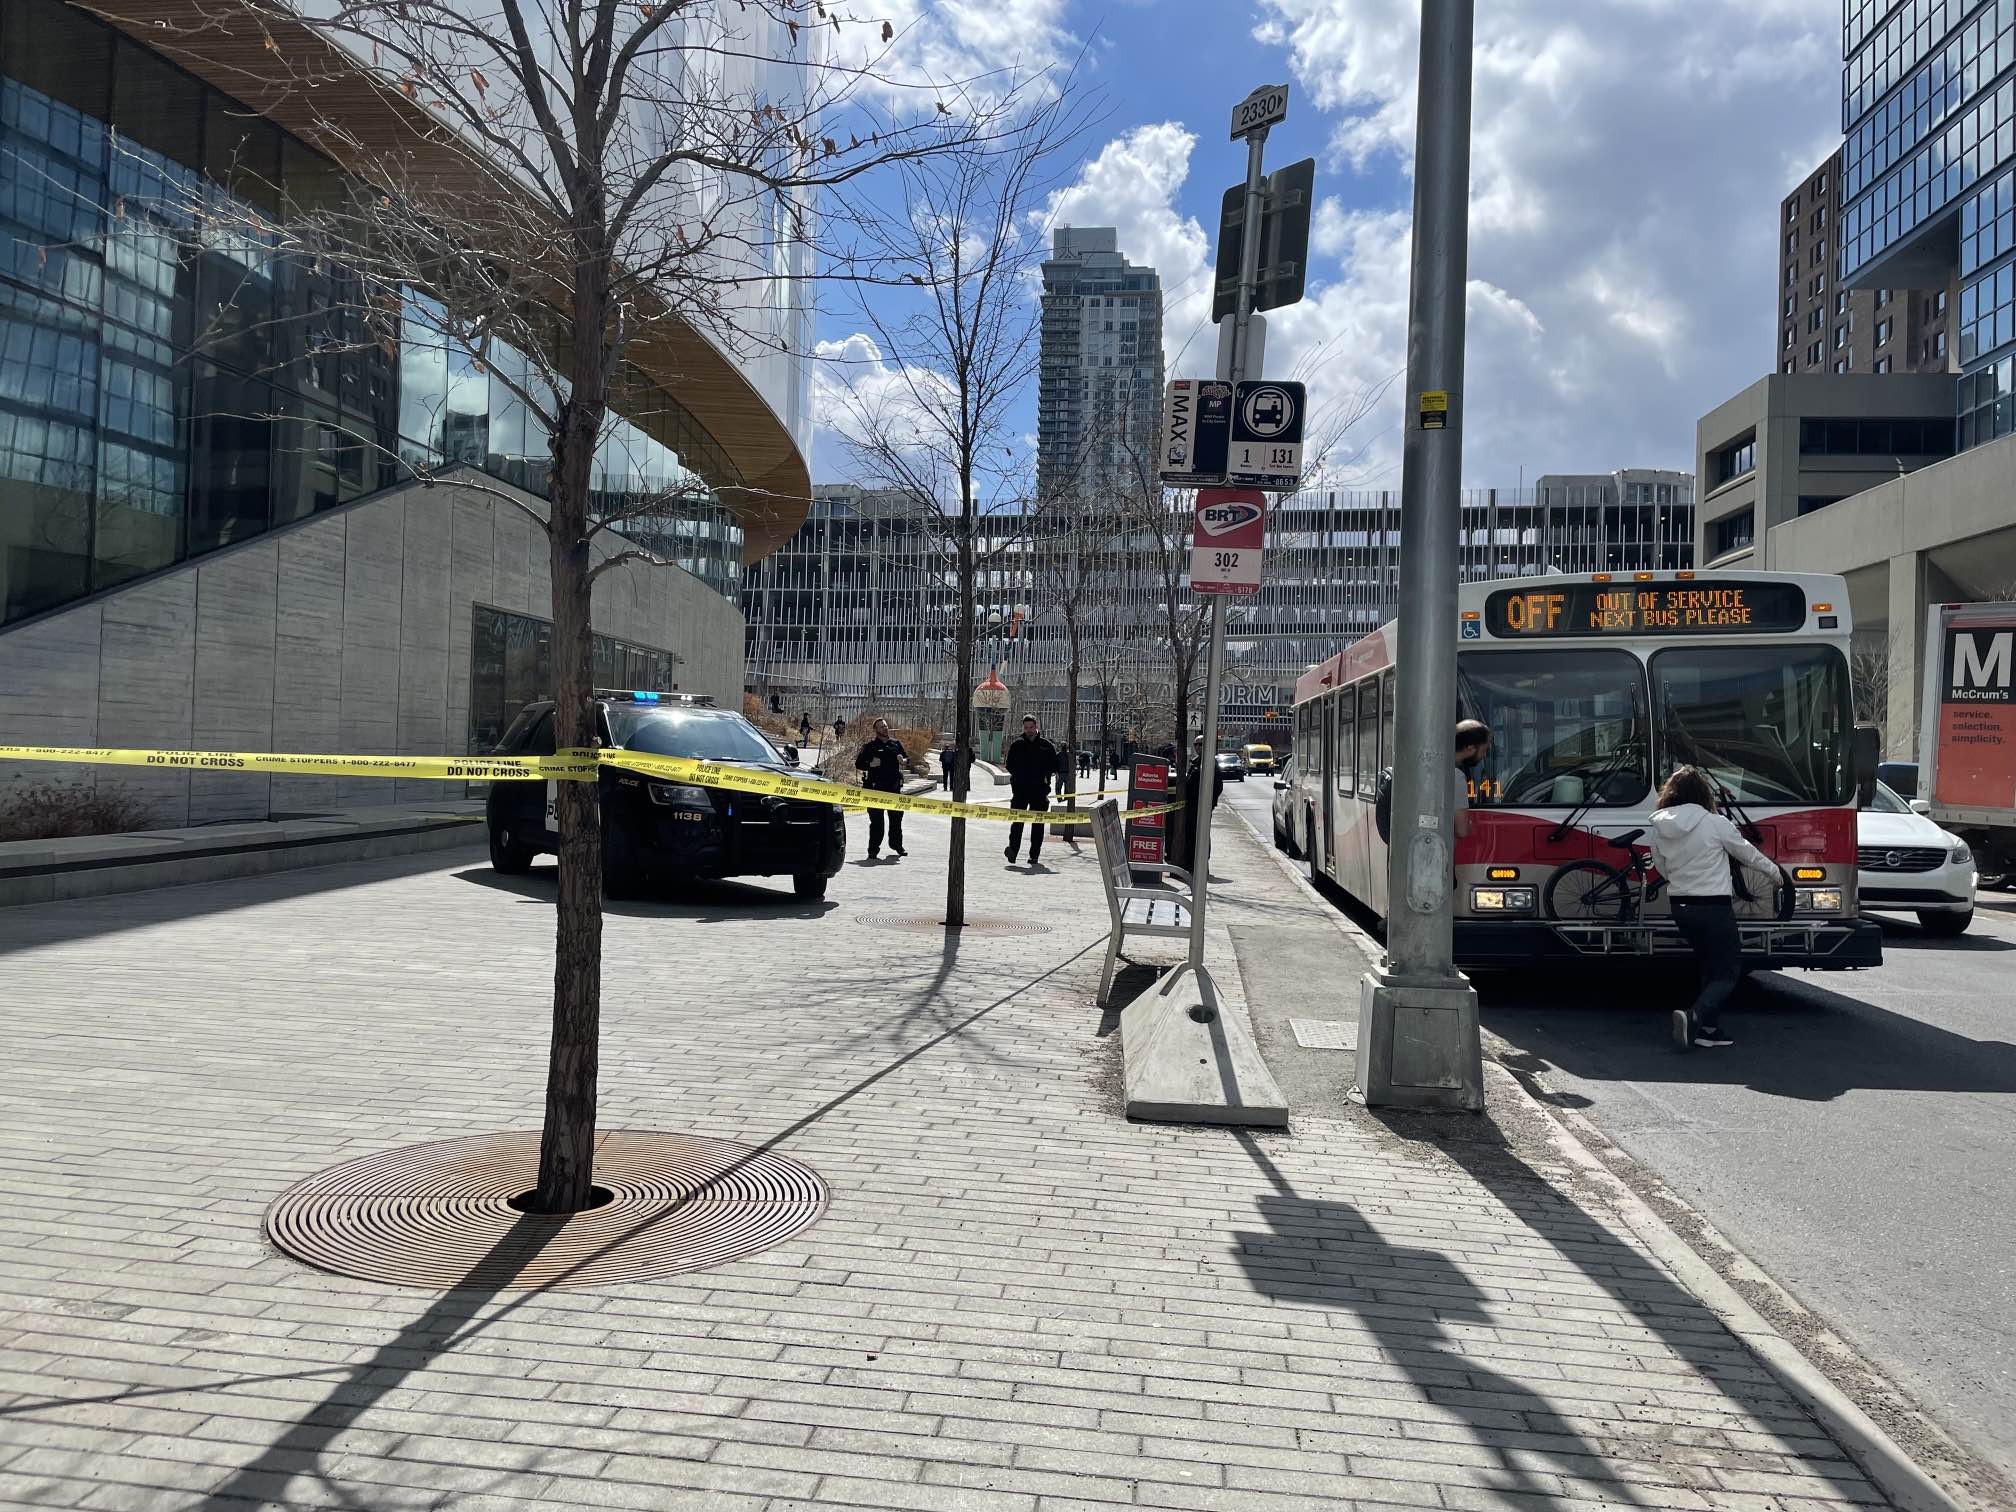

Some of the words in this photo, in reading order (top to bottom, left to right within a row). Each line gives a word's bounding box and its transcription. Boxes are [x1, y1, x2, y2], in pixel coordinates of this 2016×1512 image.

[1241, 95, 1276, 126] 2330
[1208, 400, 1222, 408] MP
[1170, 395, 1189, 442] MAX
[1244, 448, 1251, 464] 1
[1271, 448, 1294, 464] 131
[1205, 509, 1240, 522] BRT
[1214, 552, 1239, 568] 302
[1597, 592, 1637, 610] OUT
[1638, 591, 1659, 609] OF
[1668, 590, 1744, 609] SERVICE
[1507, 594, 1565, 629] OFF
[1590, 609, 1637, 627] NEXT
[1643, 608, 1679, 626] BUS
[1685, 607, 1752, 625] PLEASE
[1952, 632, 2014, 688] M
[1952, 689, 2009, 700] McCrum's
[1953, 710, 1993, 719] service.
[1952, 722, 2003, 732] selection.
[1951, 733, 2005, 744] simplicity.
[147, 755, 165, 764] DO
[170, 756, 197, 765] NOT
[200, 757, 245, 767] CROSS
[255, 755, 286, 763] CRIME
[290, 757, 338, 765] STOPPERS
[447, 767, 462, 776] DO
[467, 767, 488, 777] NOT
[493, 767, 530, 777] CROSS
[1467, 779, 1503, 798] 141
[672, 811, 703, 821] 1138
[1133, 840, 1158, 851] FREE
